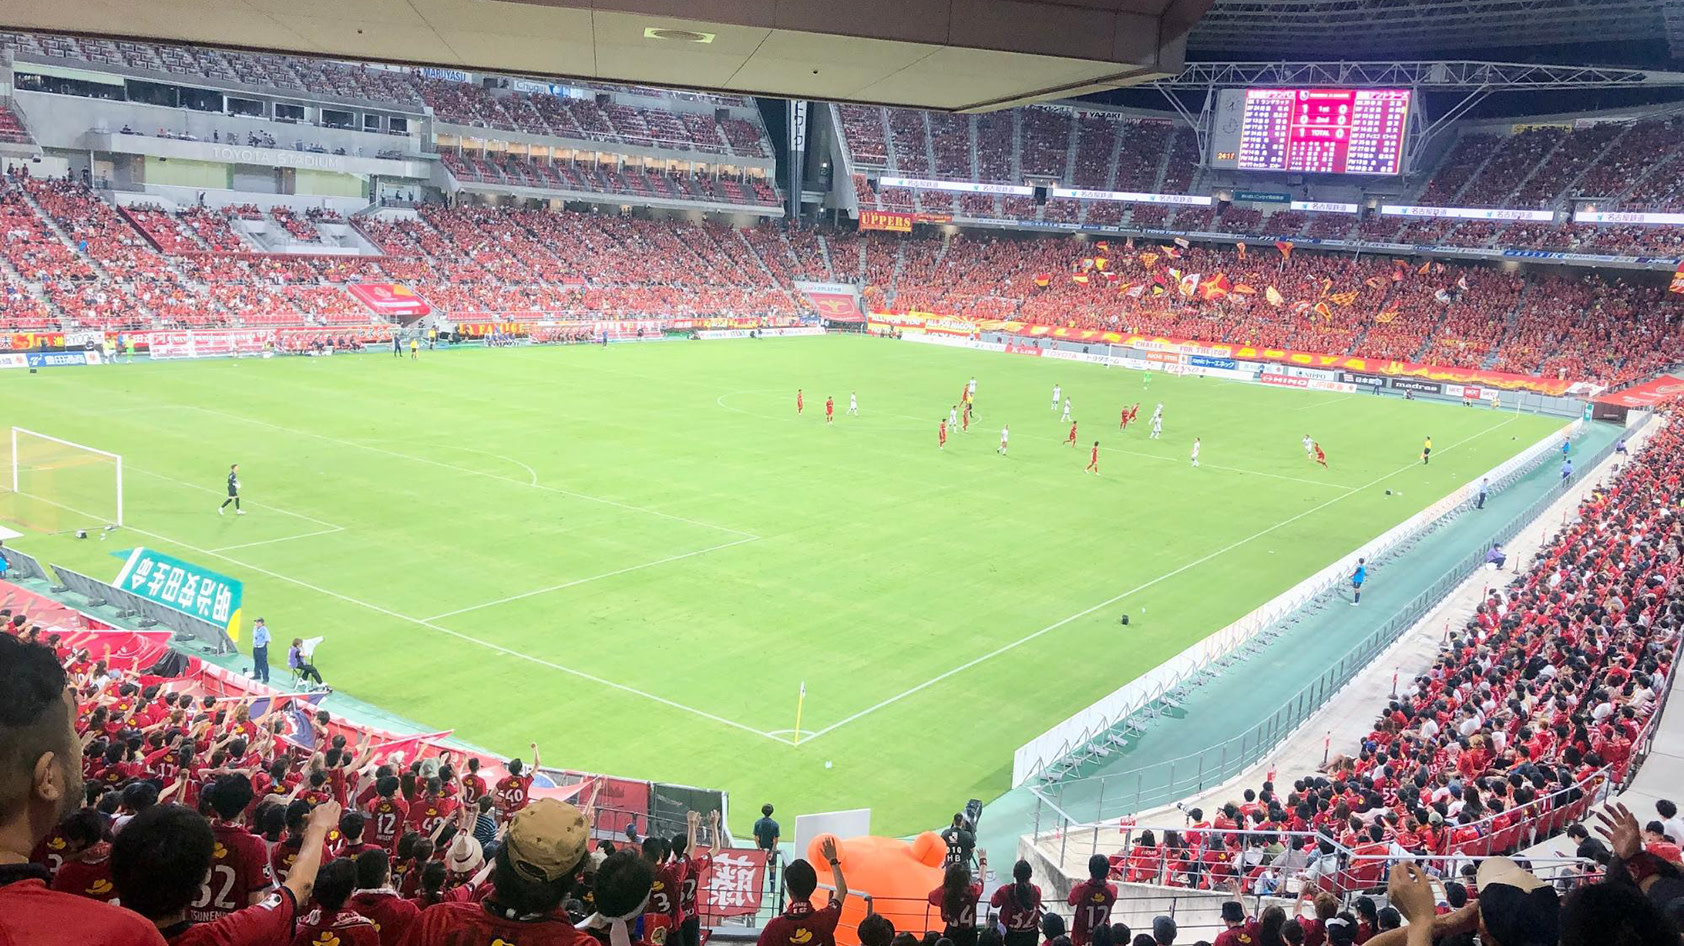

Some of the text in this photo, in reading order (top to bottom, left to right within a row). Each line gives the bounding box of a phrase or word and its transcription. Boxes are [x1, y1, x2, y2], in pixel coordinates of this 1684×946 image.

[1302, 104, 1308, 113] 1
[1338, 104, 1348, 114] 0
[1090, 111, 1121, 120] YAZAKI
[1300, 115, 1308, 124] 0
[1337, 115, 1346, 125] 0
[1299, 127, 1305, 138] 1
[1335, 128, 1345, 138] 0
[213, 147, 339, 169] TOYOTA STADIUM
[1046, 350, 1077, 359] TOYOTA
[1273, 377, 1307, 386] HINO
[1396, 382, 1437, 391] madras
[131, 557, 232, 624] 明治安田生命
[1382, 788, 1397, 800] 55
[377, 812, 396, 835] 12
[190, 864, 236, 909] 32
